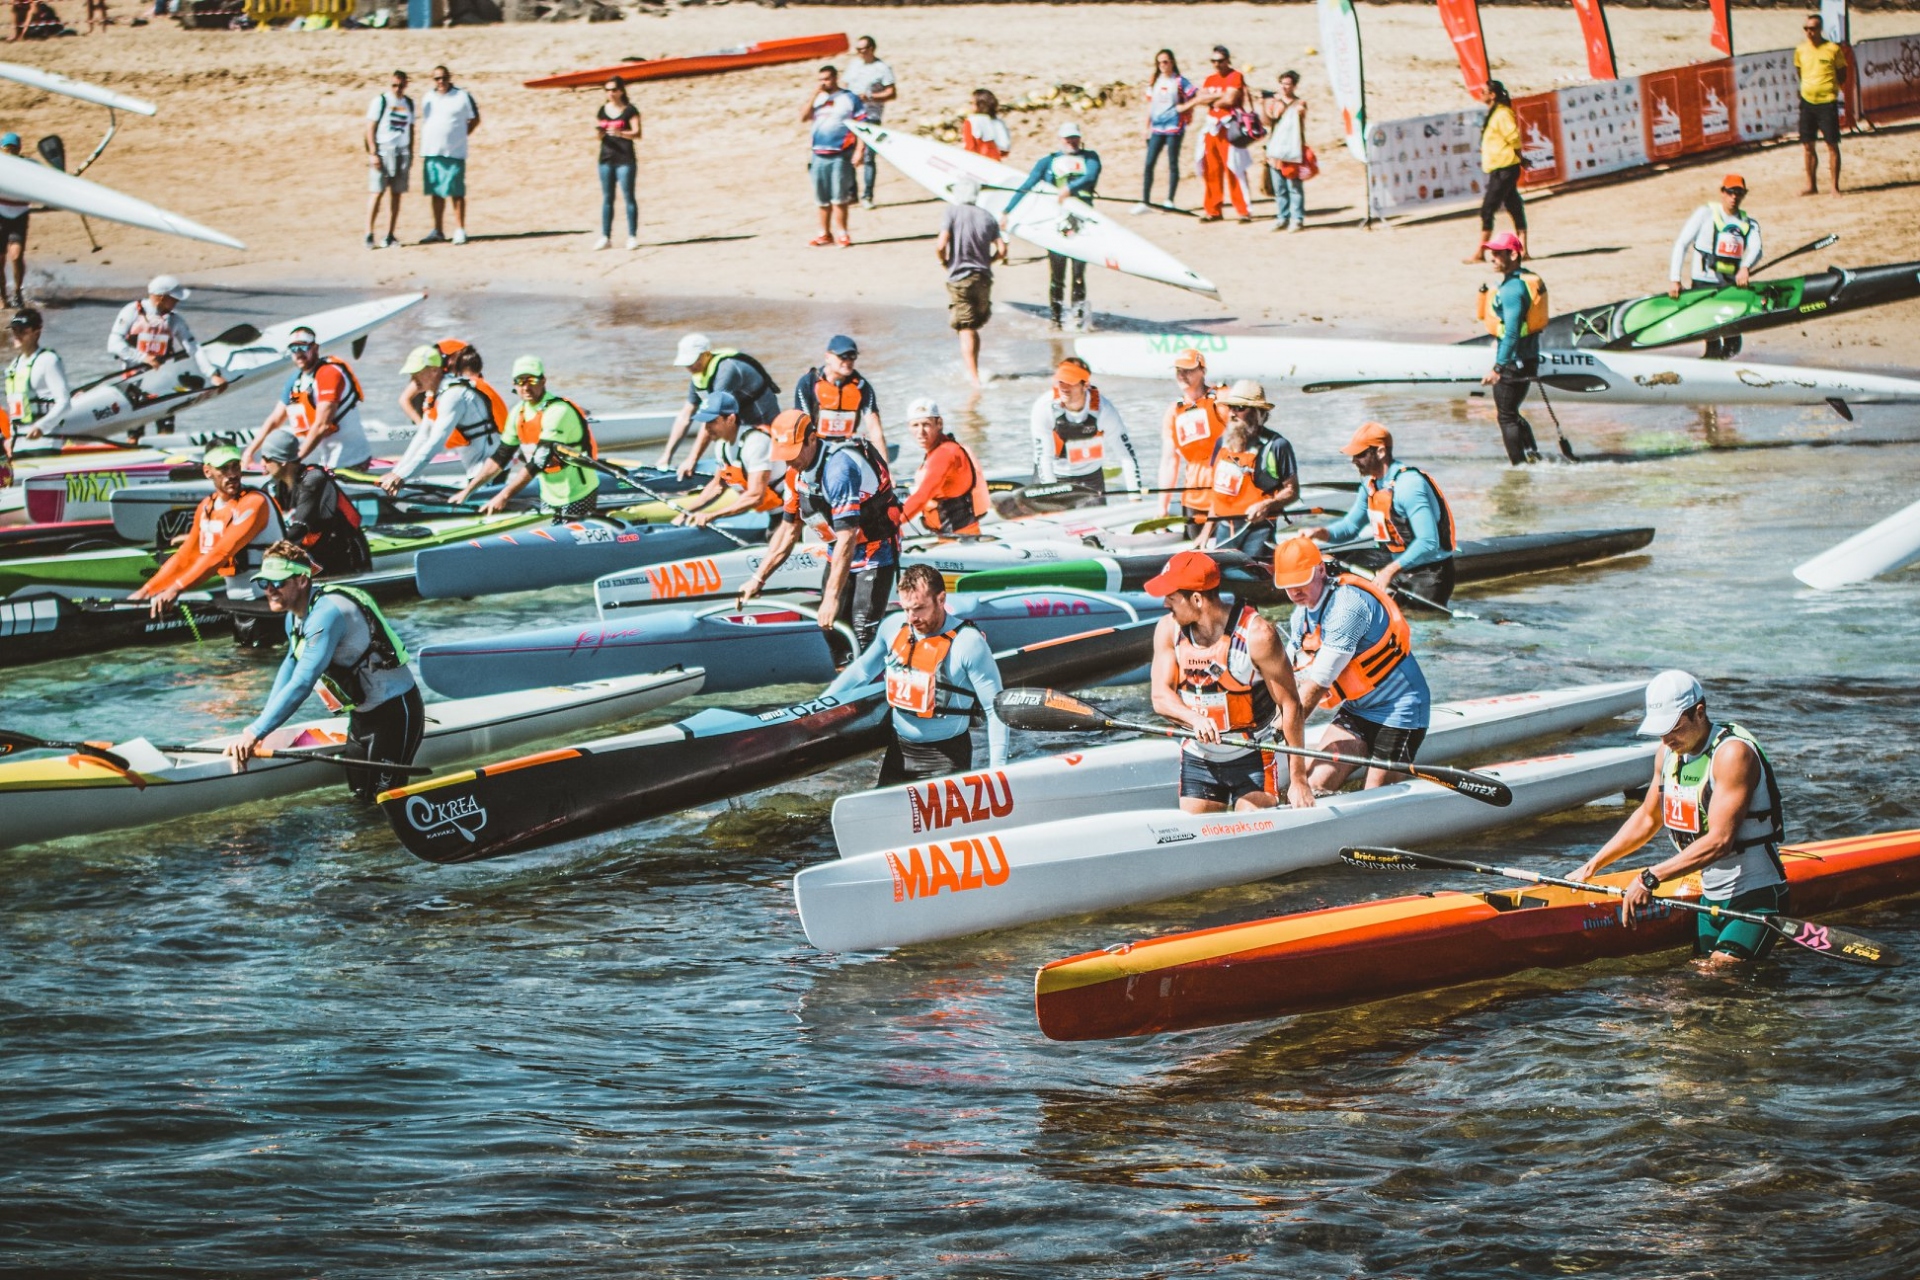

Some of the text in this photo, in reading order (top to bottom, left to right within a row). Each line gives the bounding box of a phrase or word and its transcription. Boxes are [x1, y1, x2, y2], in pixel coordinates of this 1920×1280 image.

[1552, 354, 1595, 366] ELITE
[649, 558, 722, 599] MAZU
[911, 771, 1014, 832] MAZU
[1671, 799, 1684, 821] 21
[426, 828, 456, 839] KAYAKS
[1201, 819, 1275, 837] eliokayaks.com
[892, 835, 1011, 901] MAZU
